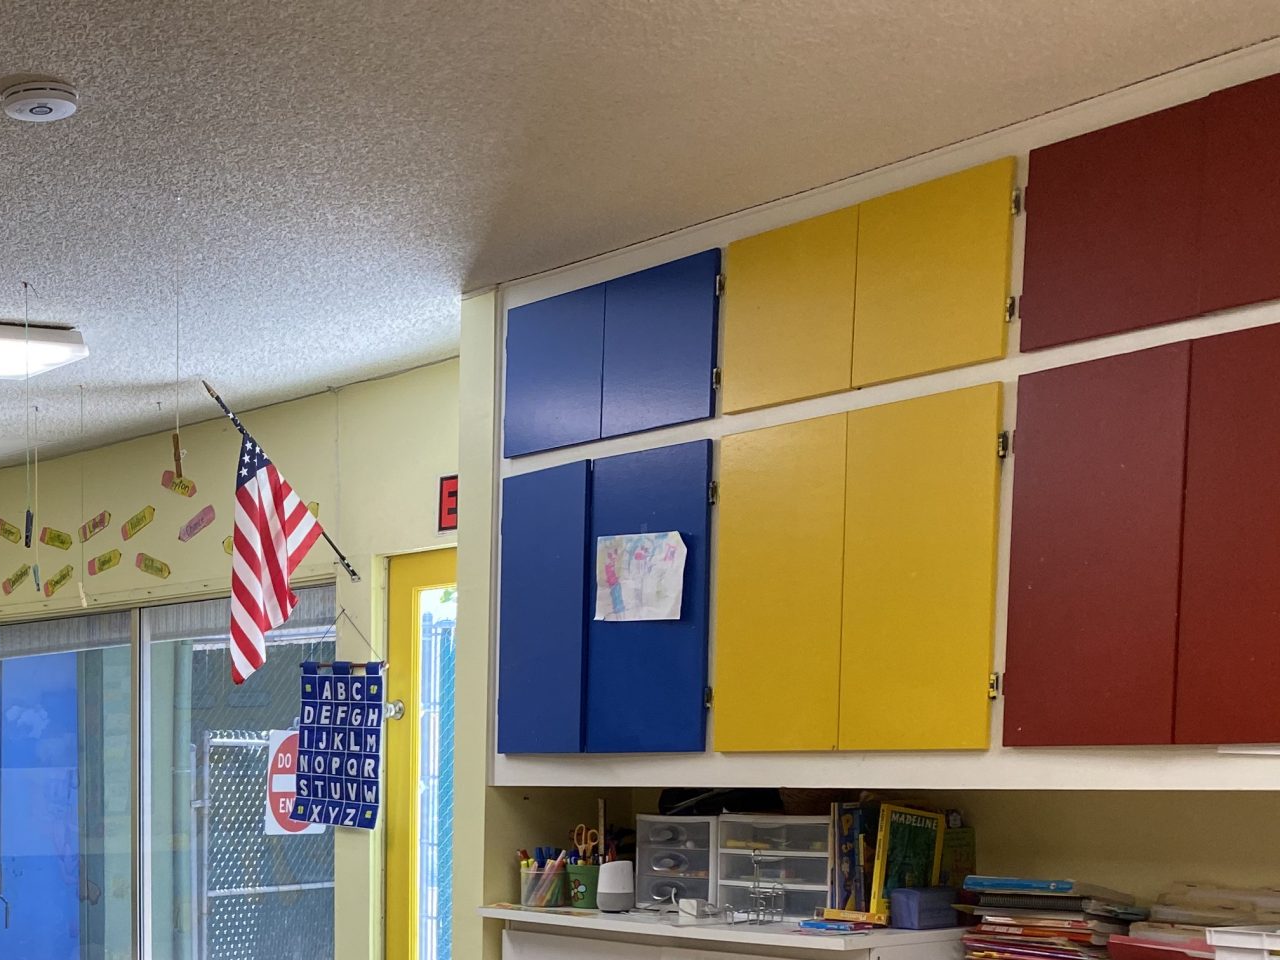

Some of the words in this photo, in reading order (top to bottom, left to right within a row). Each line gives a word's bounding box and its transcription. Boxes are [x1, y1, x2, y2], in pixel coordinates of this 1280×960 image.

[322, 681, 331, 699] A
[337, 683, 346, 700] B
[352, 683, 361, 700] C
[304, 706, 314, 723] D
[320, 706, 331, 724] E
[336, 707, 347, 725] F
[352, 709, 361, 725] G
[368, 708, 378, 726] H
[319, 732, 326, 749] J
[334, 733, 343, 750] K
[350, 732, 360, 750] L
[367, 735, 376, 753] M
[278, 753, 291, 769] DO
[300, 755, 308, 772] N
[315, 756, 324, 773] O
[332, 757, 340, 774] P
[347, 759, 357, 776] Q
[364, 759, 375, 777] R
[300, 780, 308, 796] S
[315, 781, 324, 797] T
[331, 782, 340, 799] U
[347, 783, 357, 800] V
[364, 786, 376, 803] W
[279, 798, 295, 813] EN
[310, 805, 321, 822] X
[328, 807, 339, 823] Y
[344, 808, 355, 825] Z
[891, 812, 938, 830] MADELINE
